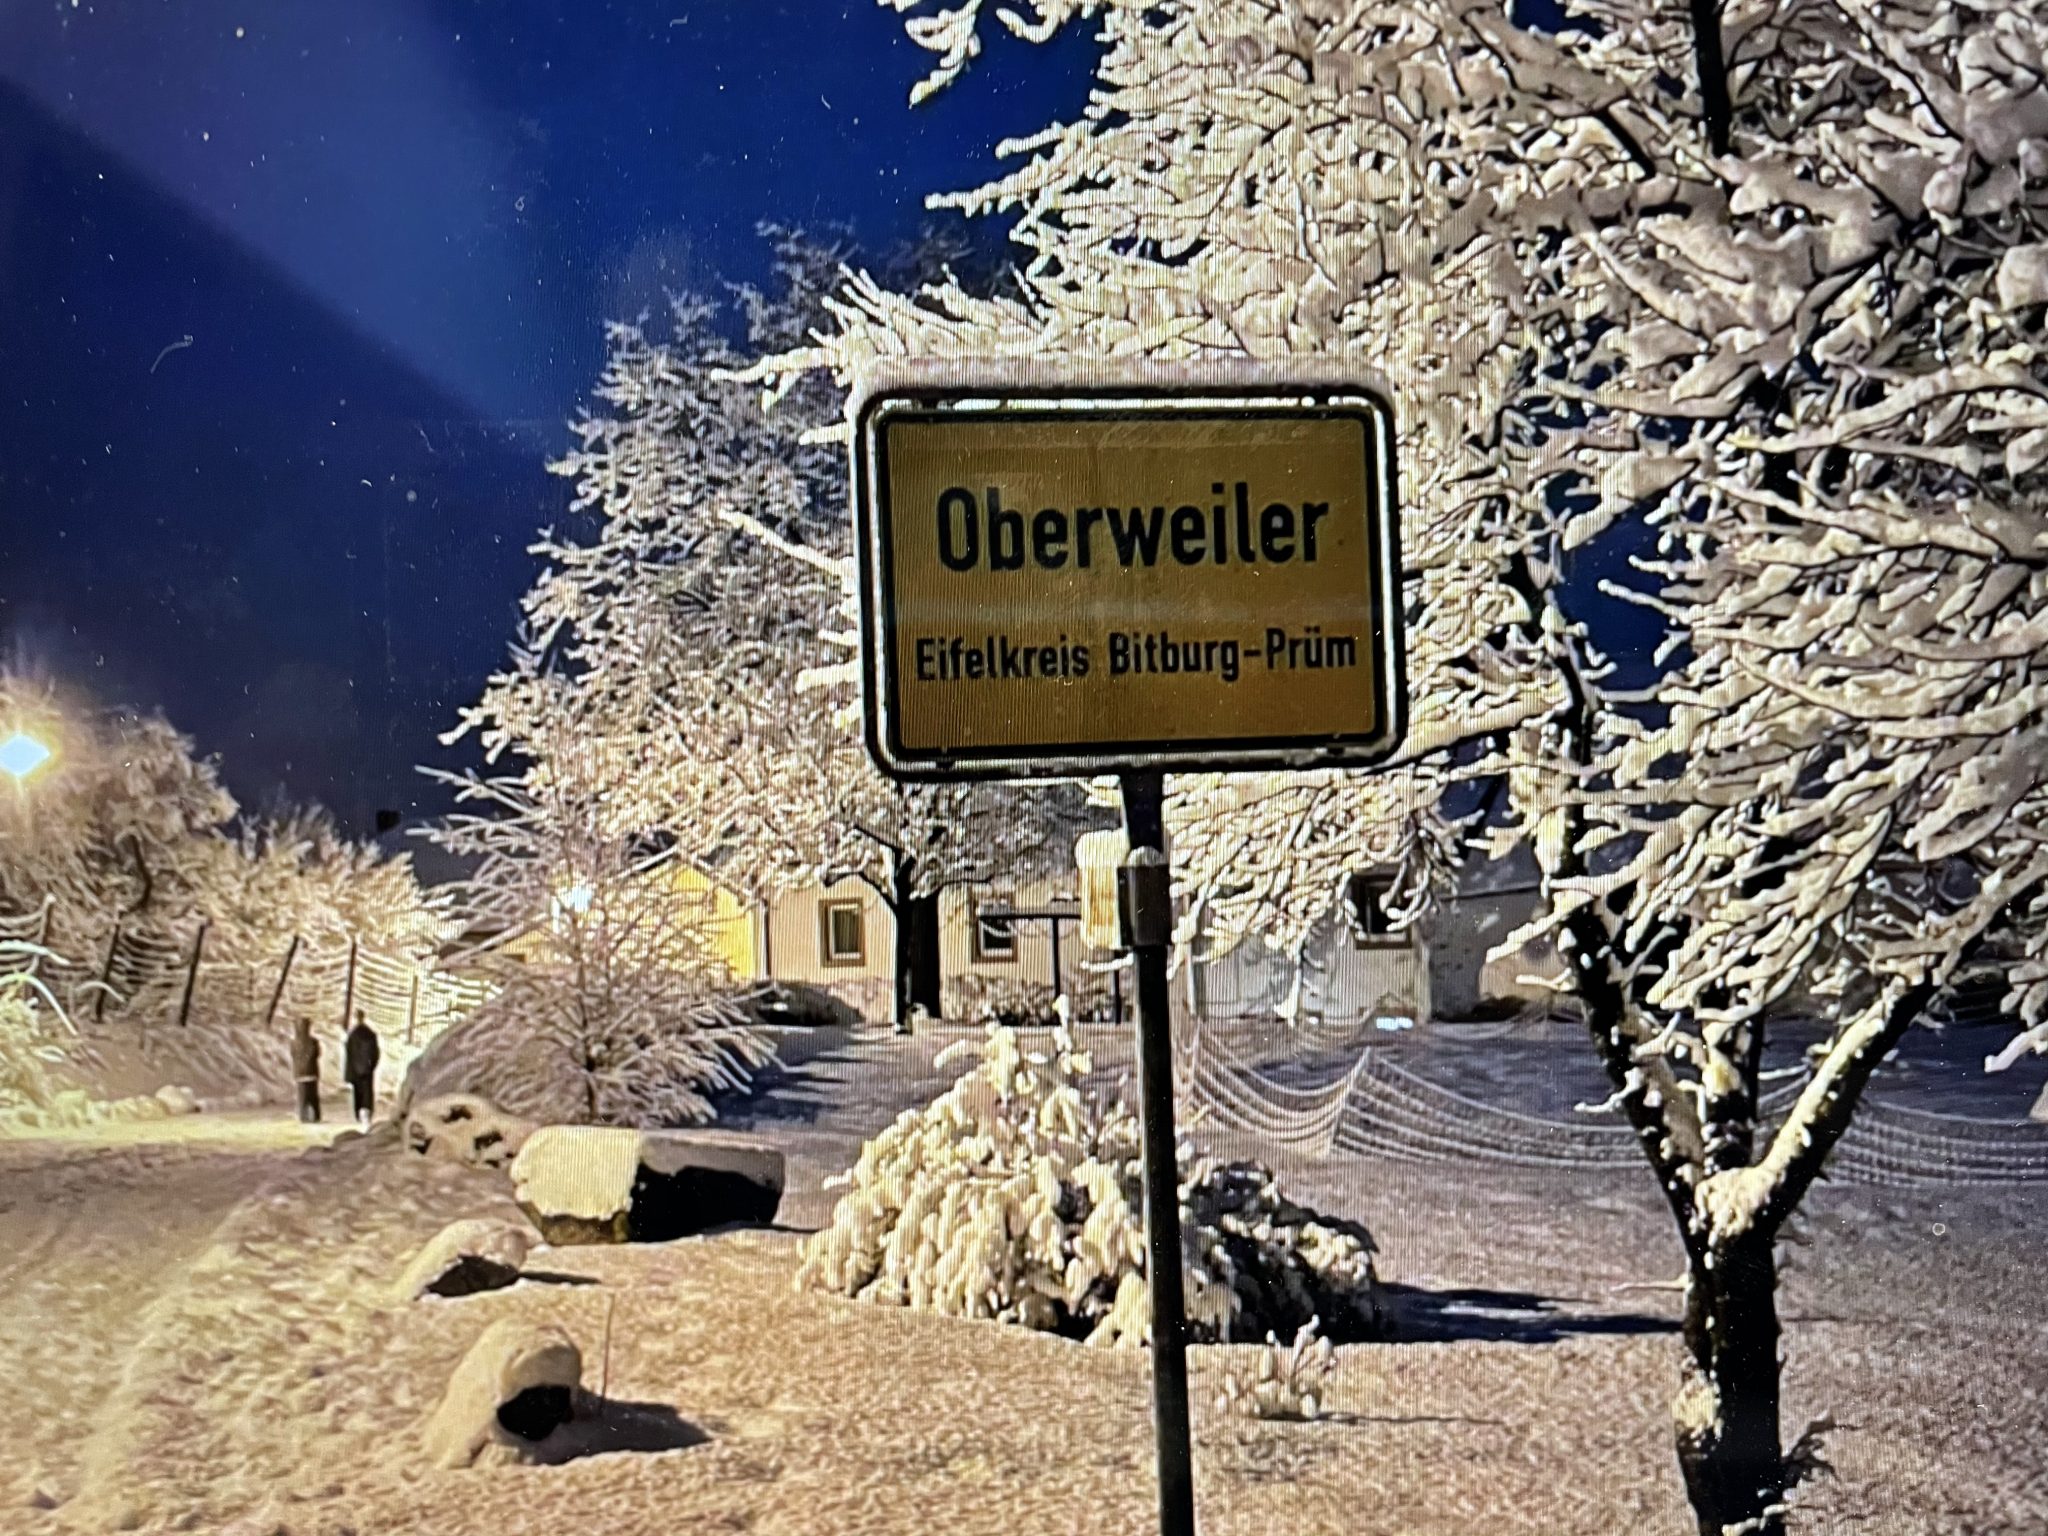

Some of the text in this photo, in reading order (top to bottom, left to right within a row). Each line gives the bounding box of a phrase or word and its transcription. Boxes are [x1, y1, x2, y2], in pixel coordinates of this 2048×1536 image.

[937, 482, 1329, 572] Oberweiler
[915, 626, 1357, 682] Eifelkreis Bitburg-Prüm
